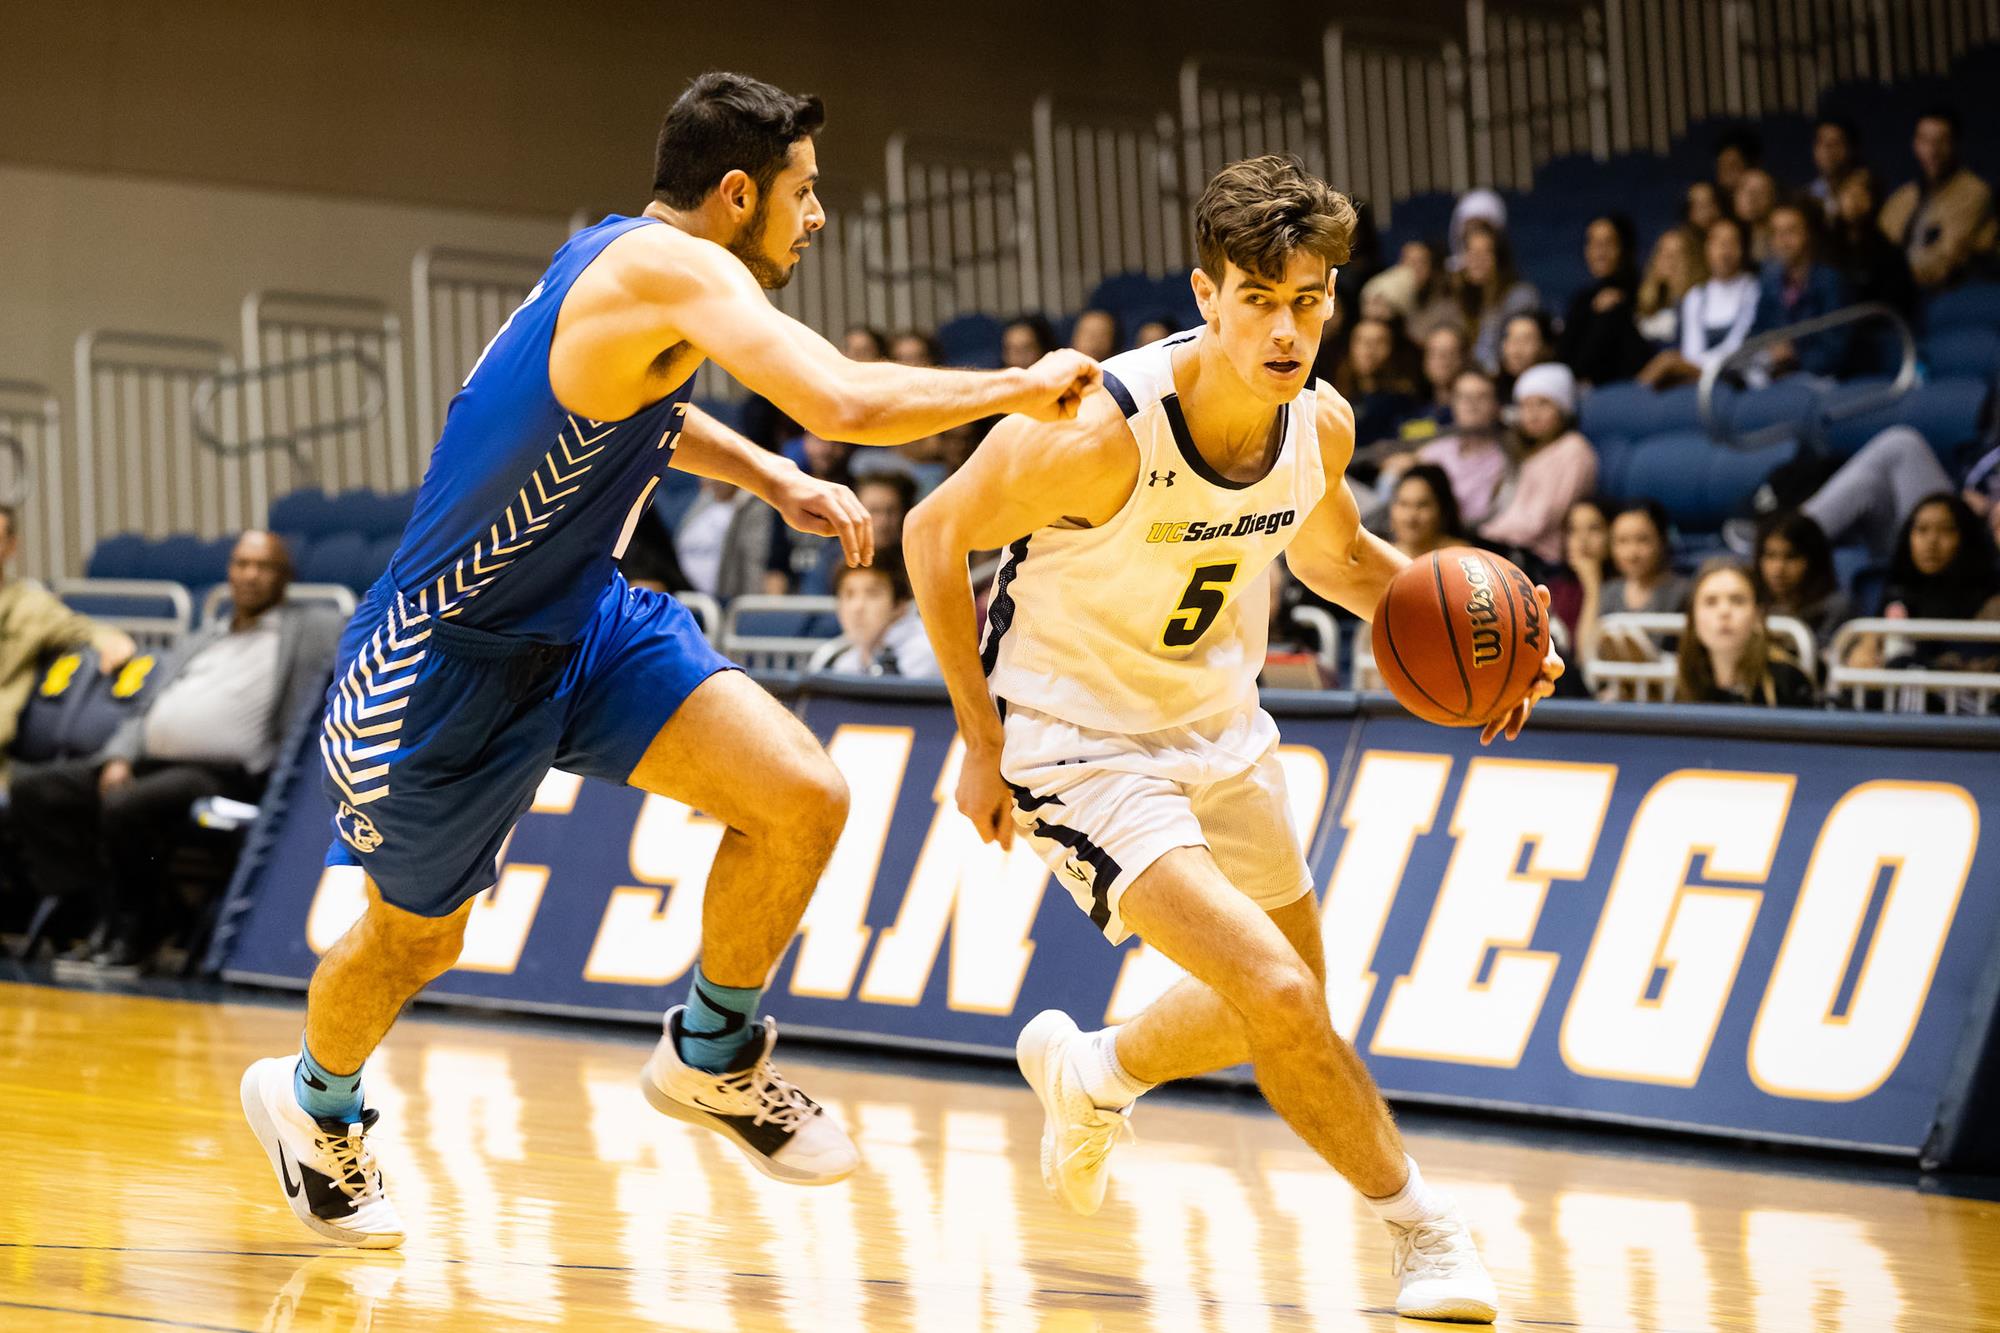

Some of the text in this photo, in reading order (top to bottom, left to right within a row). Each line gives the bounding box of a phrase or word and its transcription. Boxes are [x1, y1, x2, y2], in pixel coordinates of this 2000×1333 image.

[1231, 510, 1295, 535] Diego
[1160, 559, 1241, 650] 5
[1459, 557, 1503, 668] Wilson
